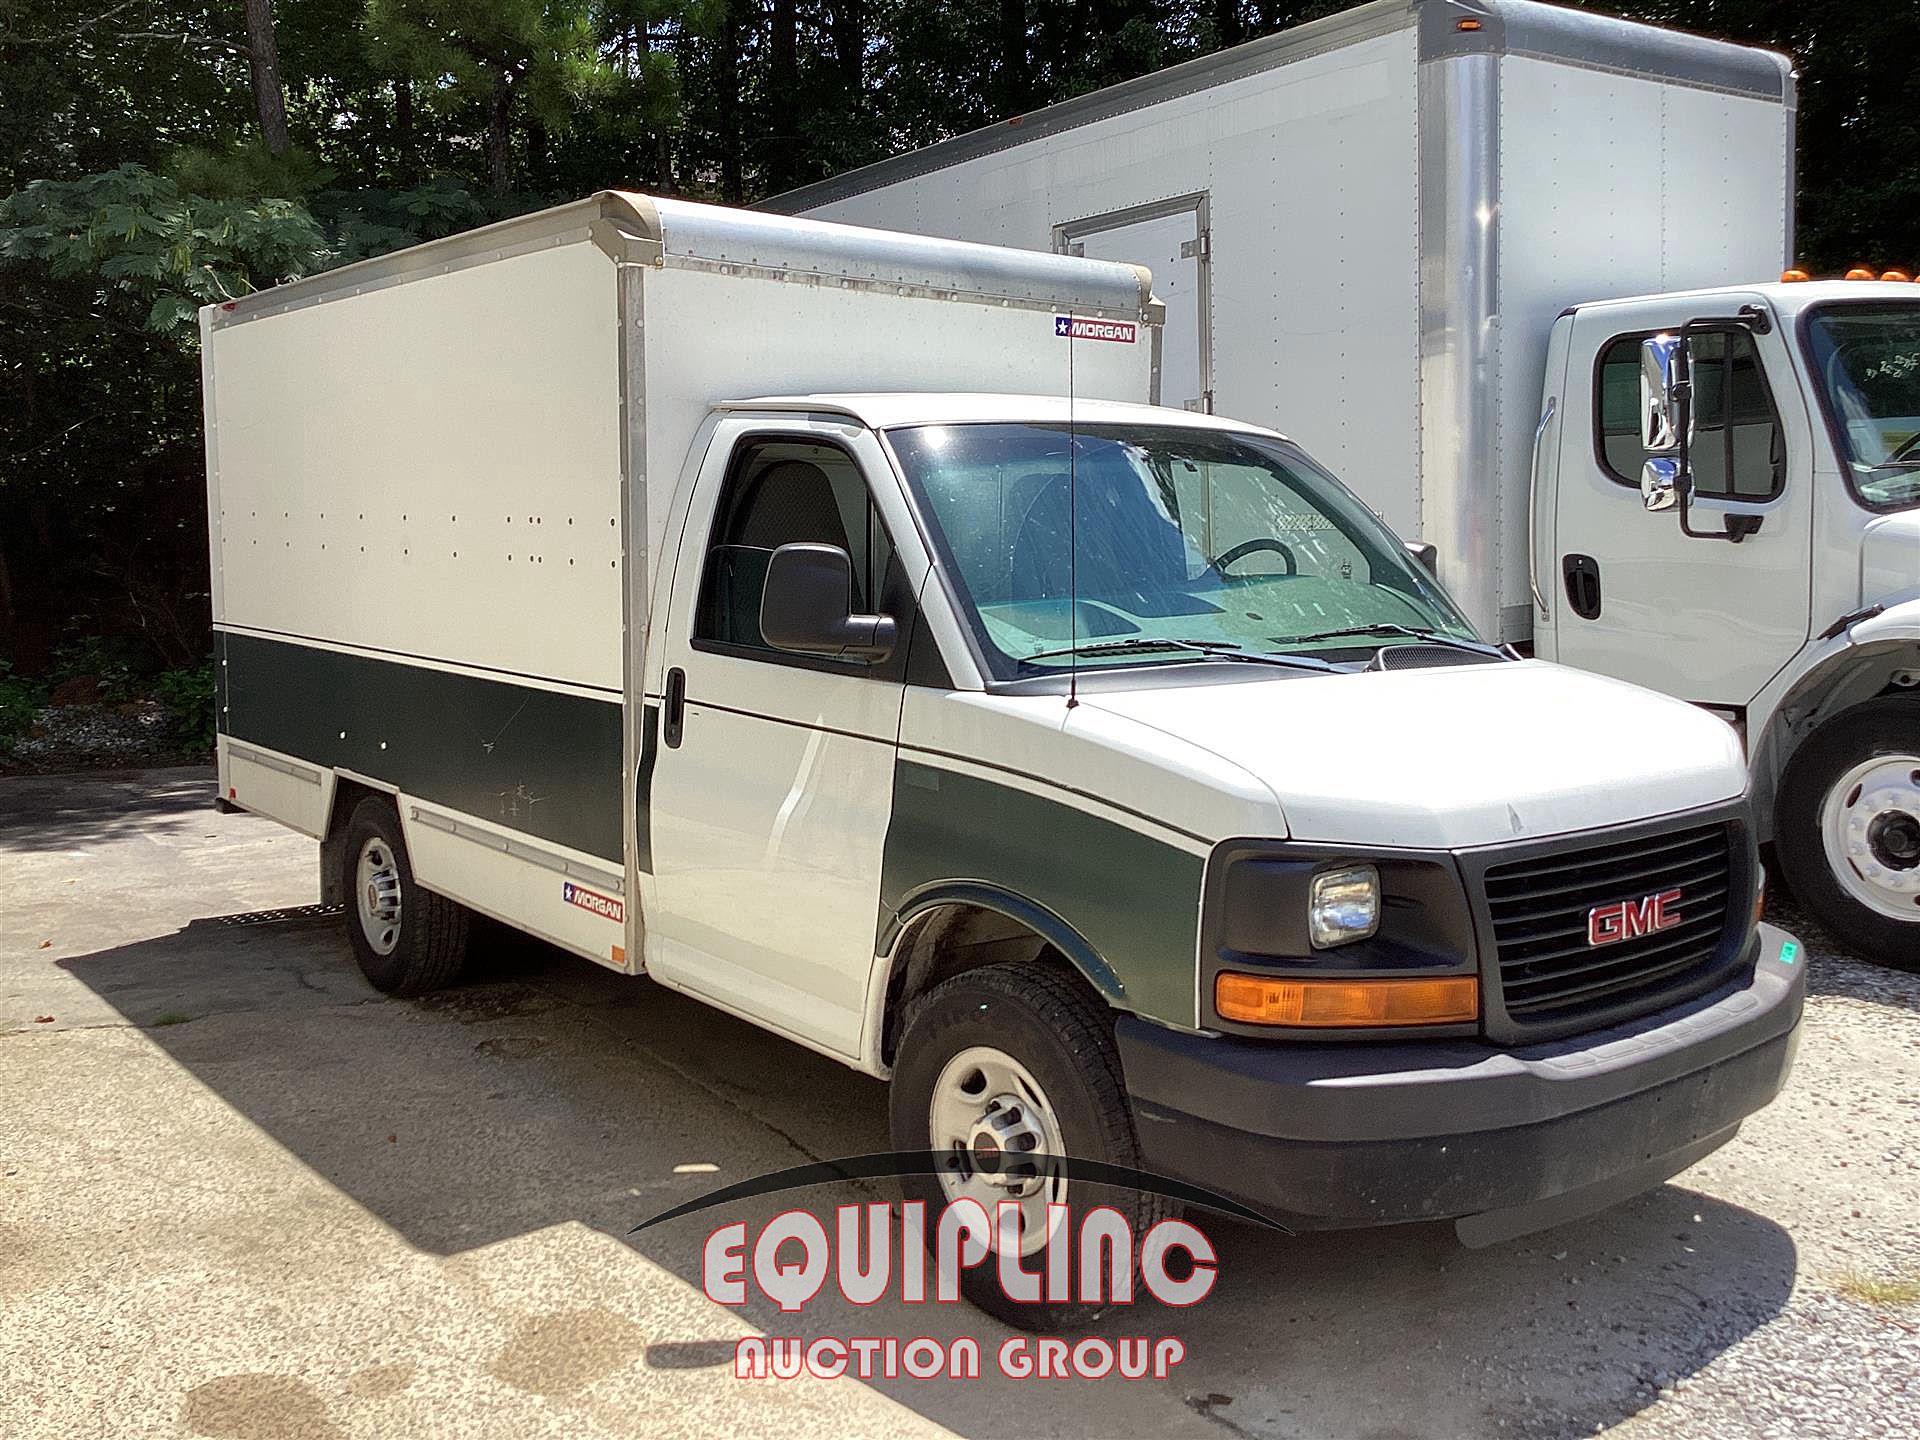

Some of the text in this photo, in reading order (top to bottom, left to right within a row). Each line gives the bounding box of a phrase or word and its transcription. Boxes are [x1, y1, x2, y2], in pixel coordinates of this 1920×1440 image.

[1072, 322, 1134, 340] MORGAN
[574, 889, 622, 919] MORGAN
[1588, 888, 1681, 945] GMC
